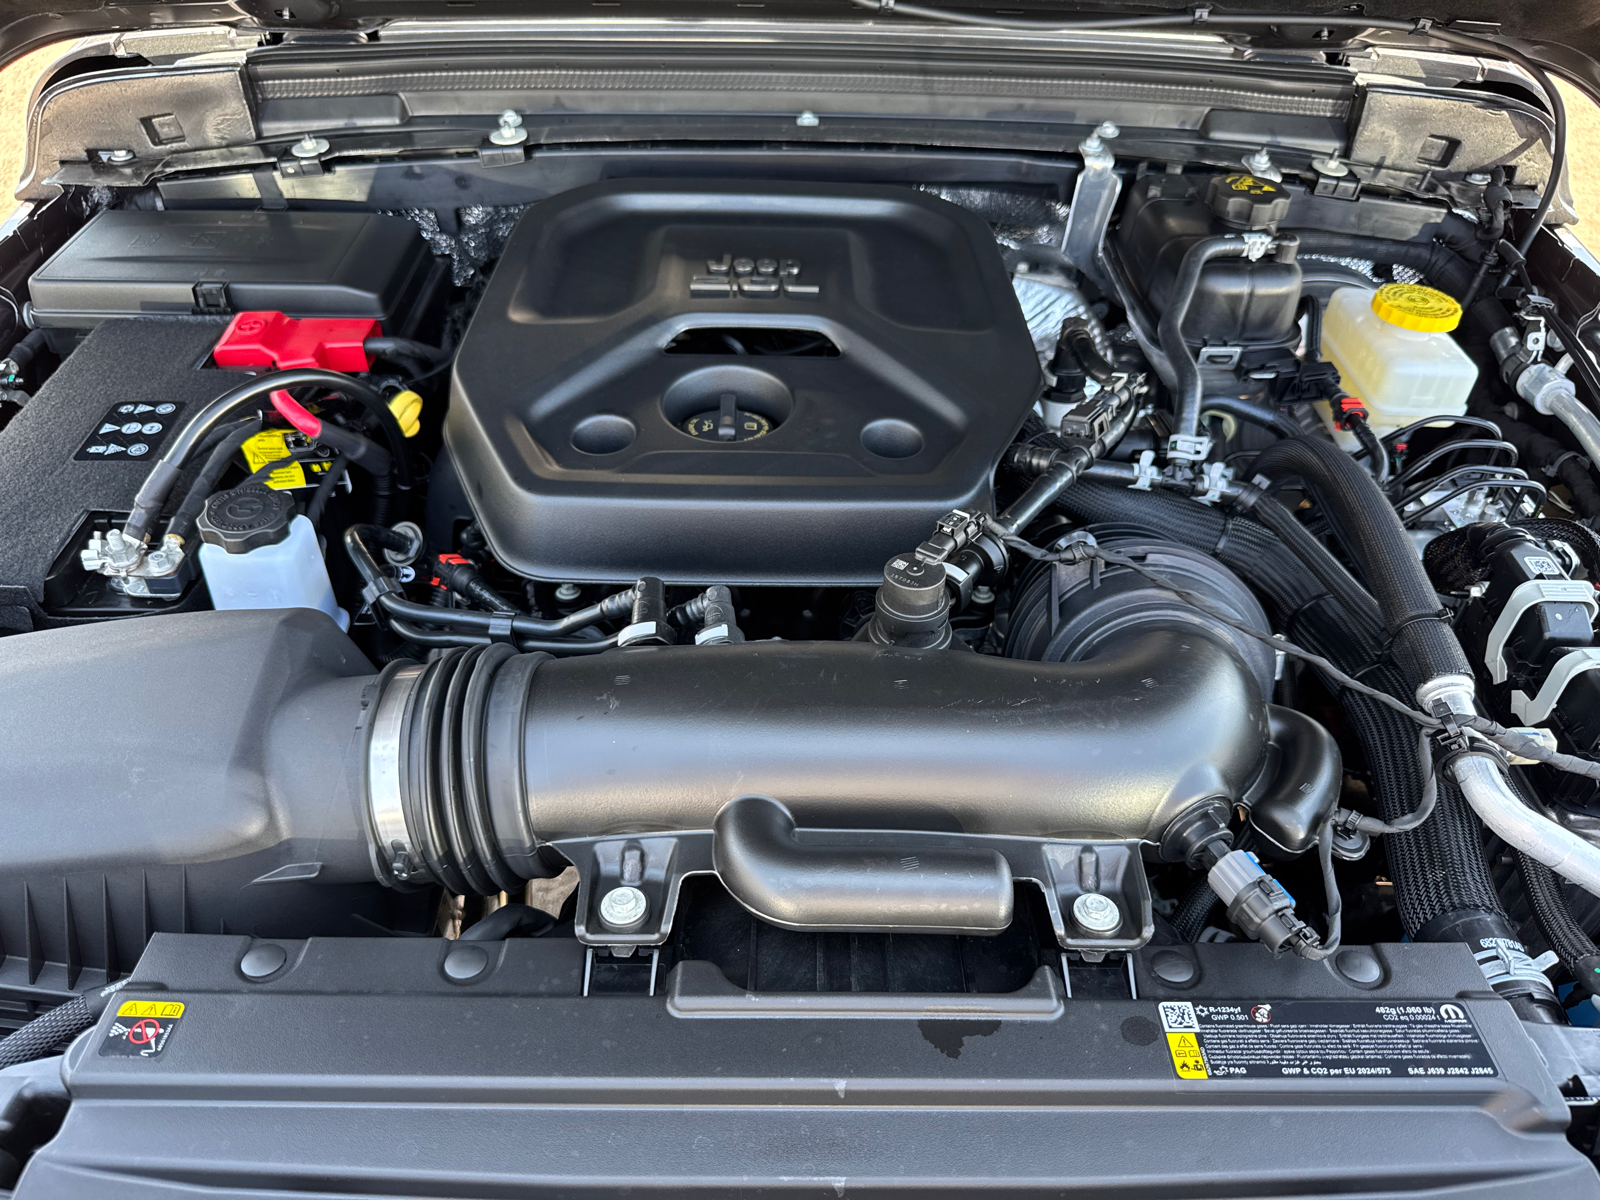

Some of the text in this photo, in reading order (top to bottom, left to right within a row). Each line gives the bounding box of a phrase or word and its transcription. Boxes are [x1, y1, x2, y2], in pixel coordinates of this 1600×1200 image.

[707, 253, 801, 277] Jeep
[1282, 1067, 1392, 1076] GWP & CO2 per EU 2024/573
[1407, 1067, 1425, 1075] SAE
[1427, 1067, 1445, 1075] J639
[1447, 1067, 1469, 1075] J2842
